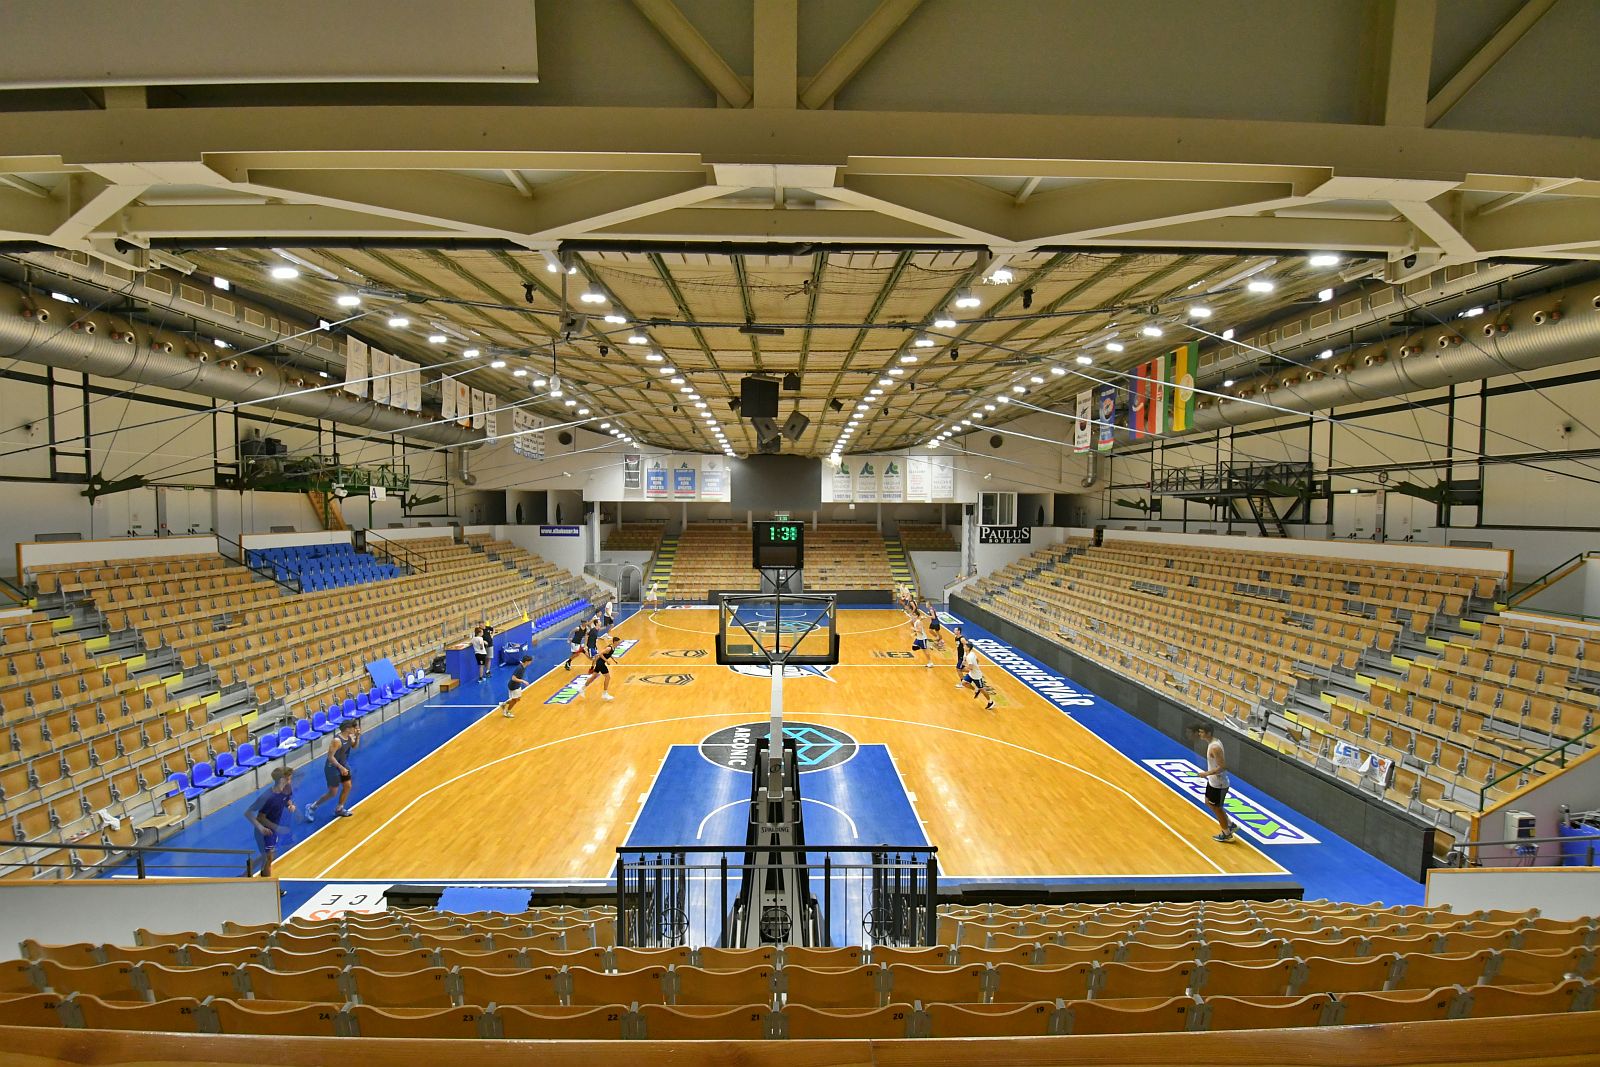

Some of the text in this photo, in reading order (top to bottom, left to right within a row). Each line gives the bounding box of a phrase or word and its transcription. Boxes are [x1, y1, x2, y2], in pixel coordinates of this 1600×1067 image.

[371, 487, 378, 498] A
[981, 526, 1030, 538] PAULUS
[968, 638, 1095, 707] SZÉKESFEHÉRVÁR
[728, 727, 752, 766] ARCONIC
